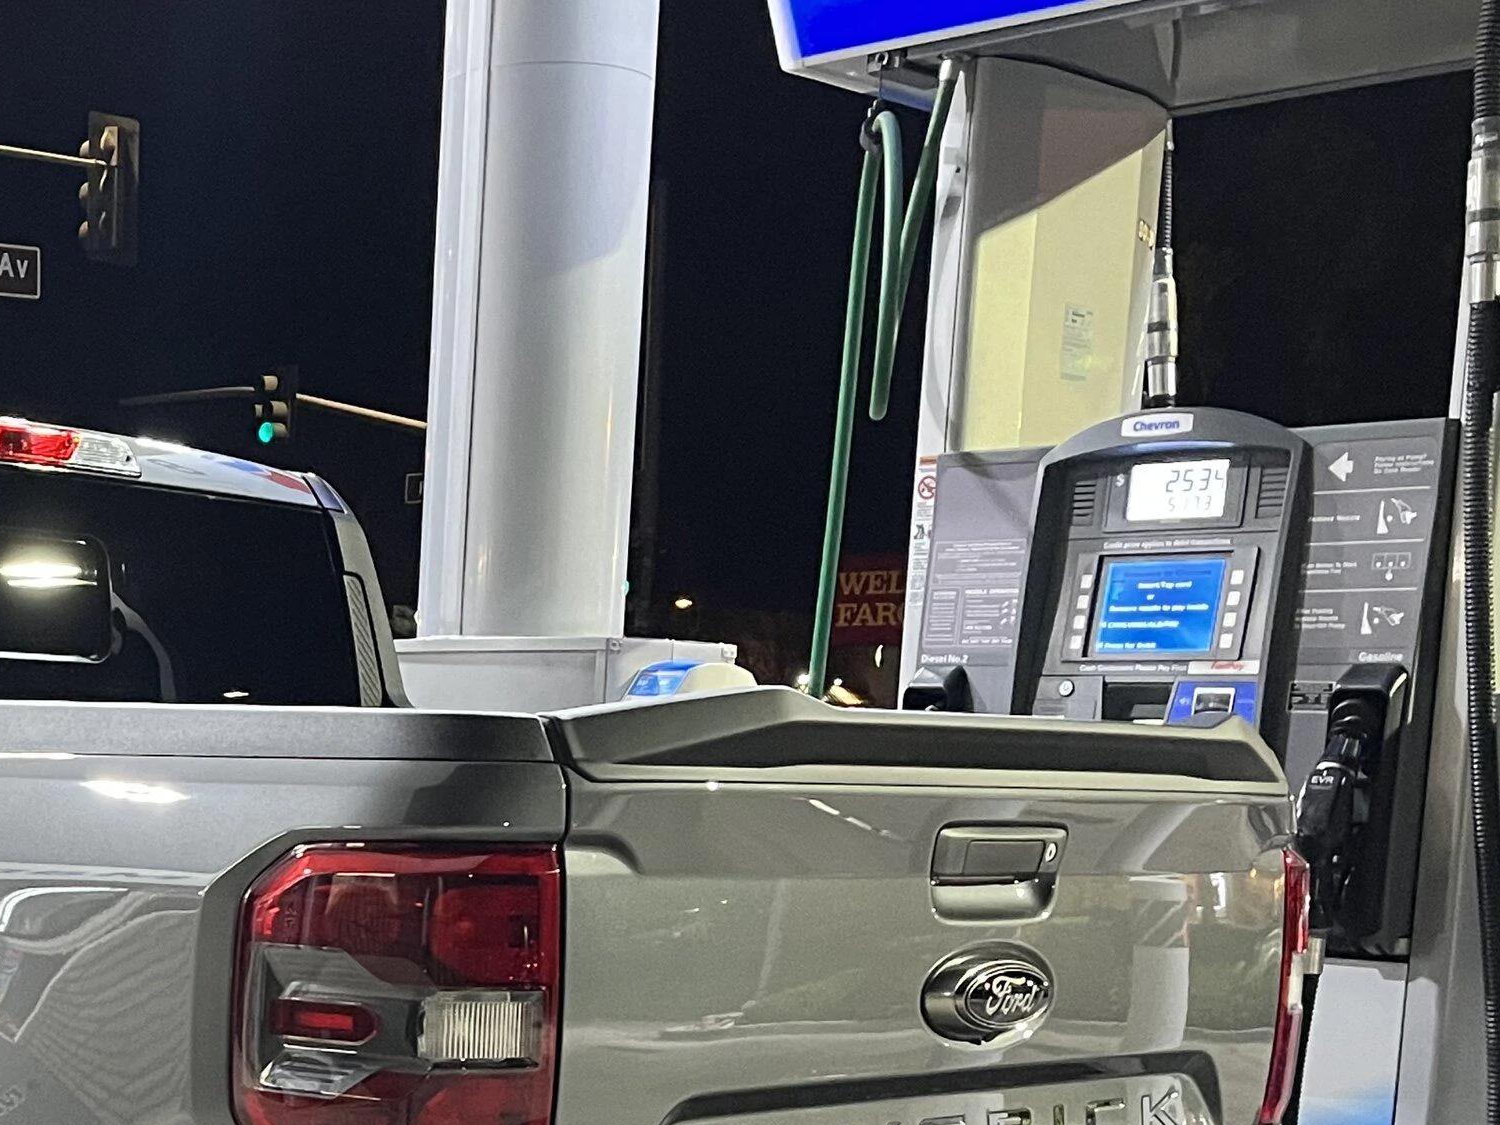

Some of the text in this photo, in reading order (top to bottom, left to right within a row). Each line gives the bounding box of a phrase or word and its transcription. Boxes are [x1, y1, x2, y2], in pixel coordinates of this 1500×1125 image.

[1133, 420, 1180, 432] Chevron
[838, 570, 904, 595] WEL
[921, 654, 948, 664] Diesel
[1358, 651, 1404, 662] Gasoline
[1311, 776, 1335, 785] EVR
[986, 974, 1040, 1017] Ford
